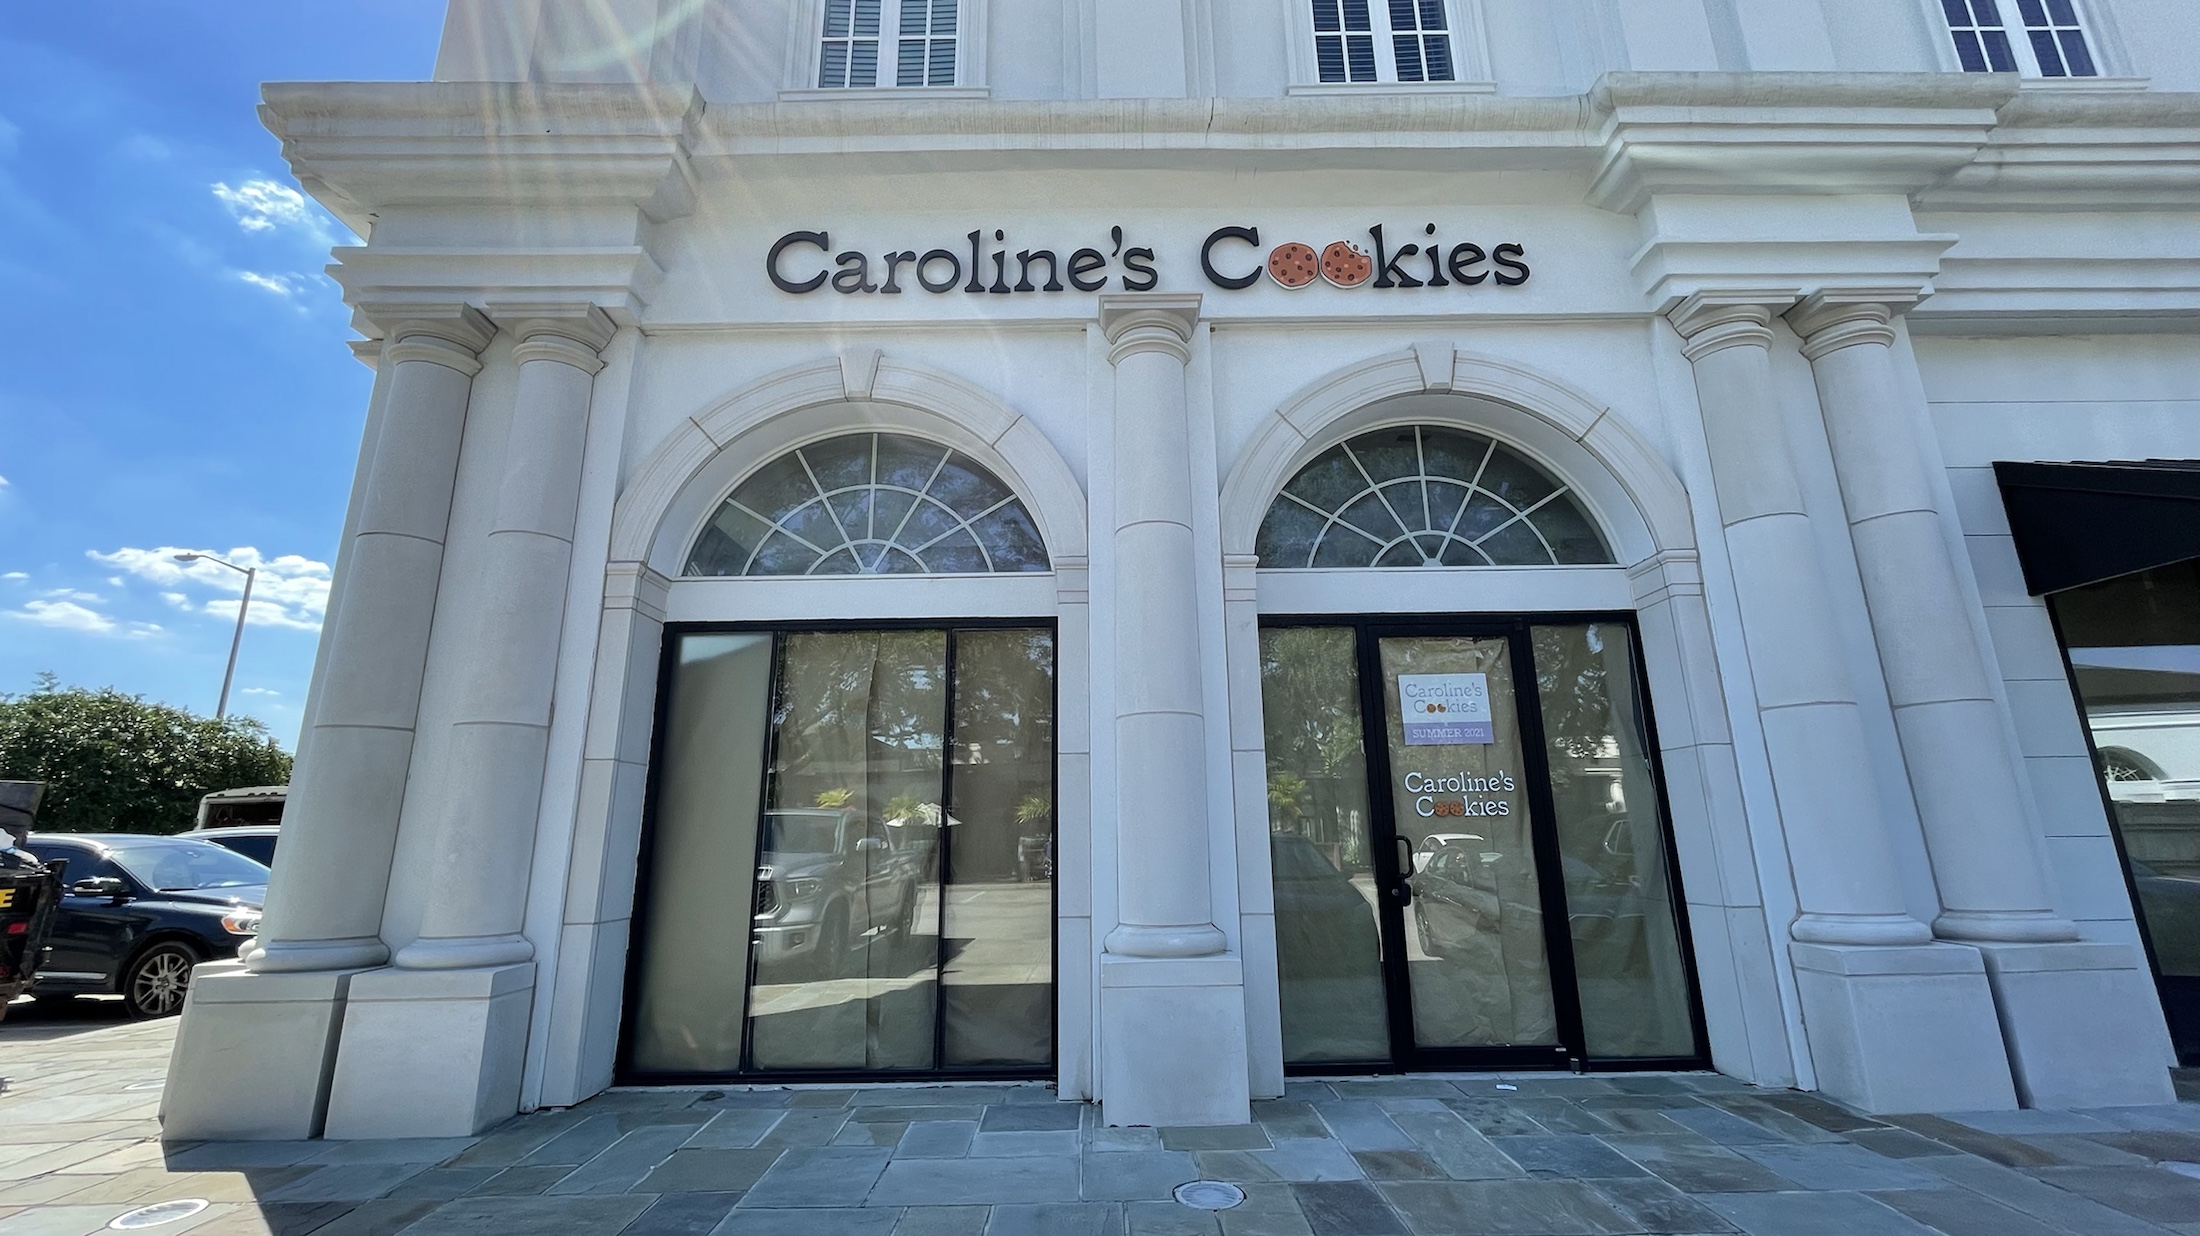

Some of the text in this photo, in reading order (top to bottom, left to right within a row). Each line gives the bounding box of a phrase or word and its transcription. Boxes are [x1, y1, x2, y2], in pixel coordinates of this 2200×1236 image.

[766, 223, 1531, 294] Caroline's Cookies
[1405, 682, 1483, 698] Caroline's
[1413, 698, 1478, 714] Cookies
[1412, 727, 1485, 739] SUMMER 2021
[1404, 769, 1515, 793] Caroline's
[1415, 795, 1510, 818] Cookies
